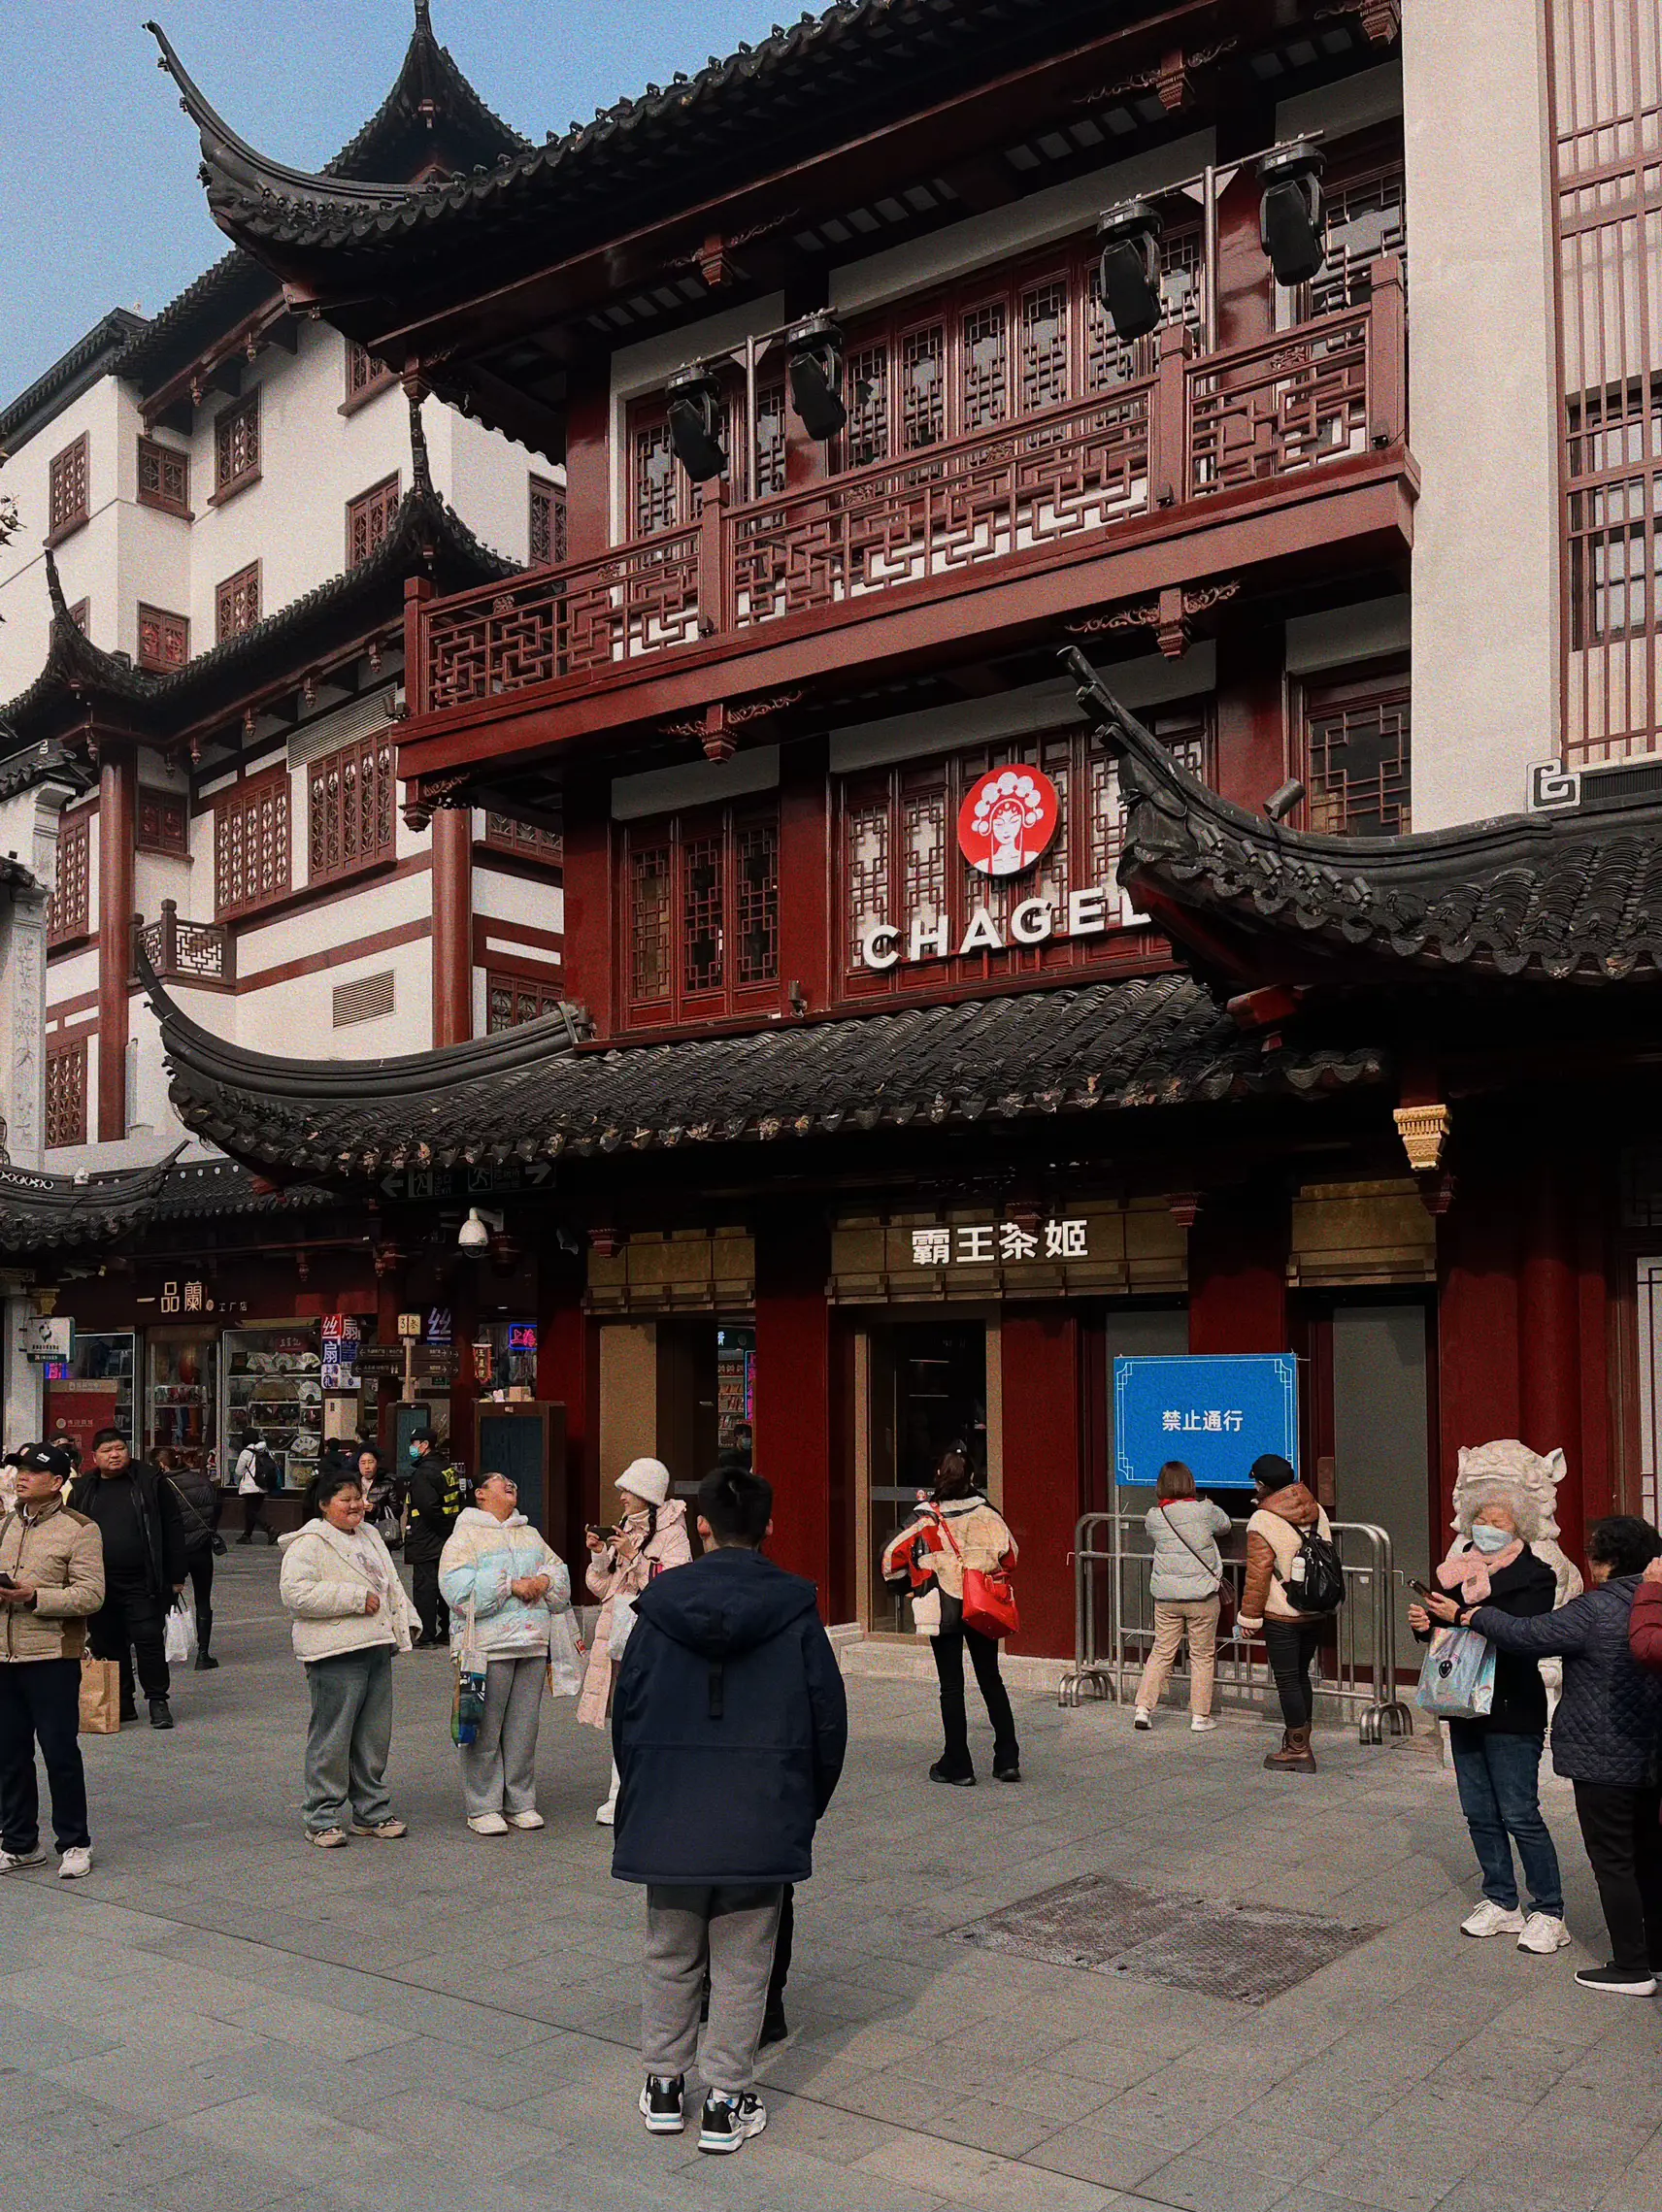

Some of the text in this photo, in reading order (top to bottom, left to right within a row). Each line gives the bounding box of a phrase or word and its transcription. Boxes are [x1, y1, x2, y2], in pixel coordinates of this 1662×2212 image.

[912, 1219, 1089, 1266] 霸王茶姬
[136, 1280, 203, 1313] 一品蘭
[1161, 1408, 1244, 1434] 禁止通行
